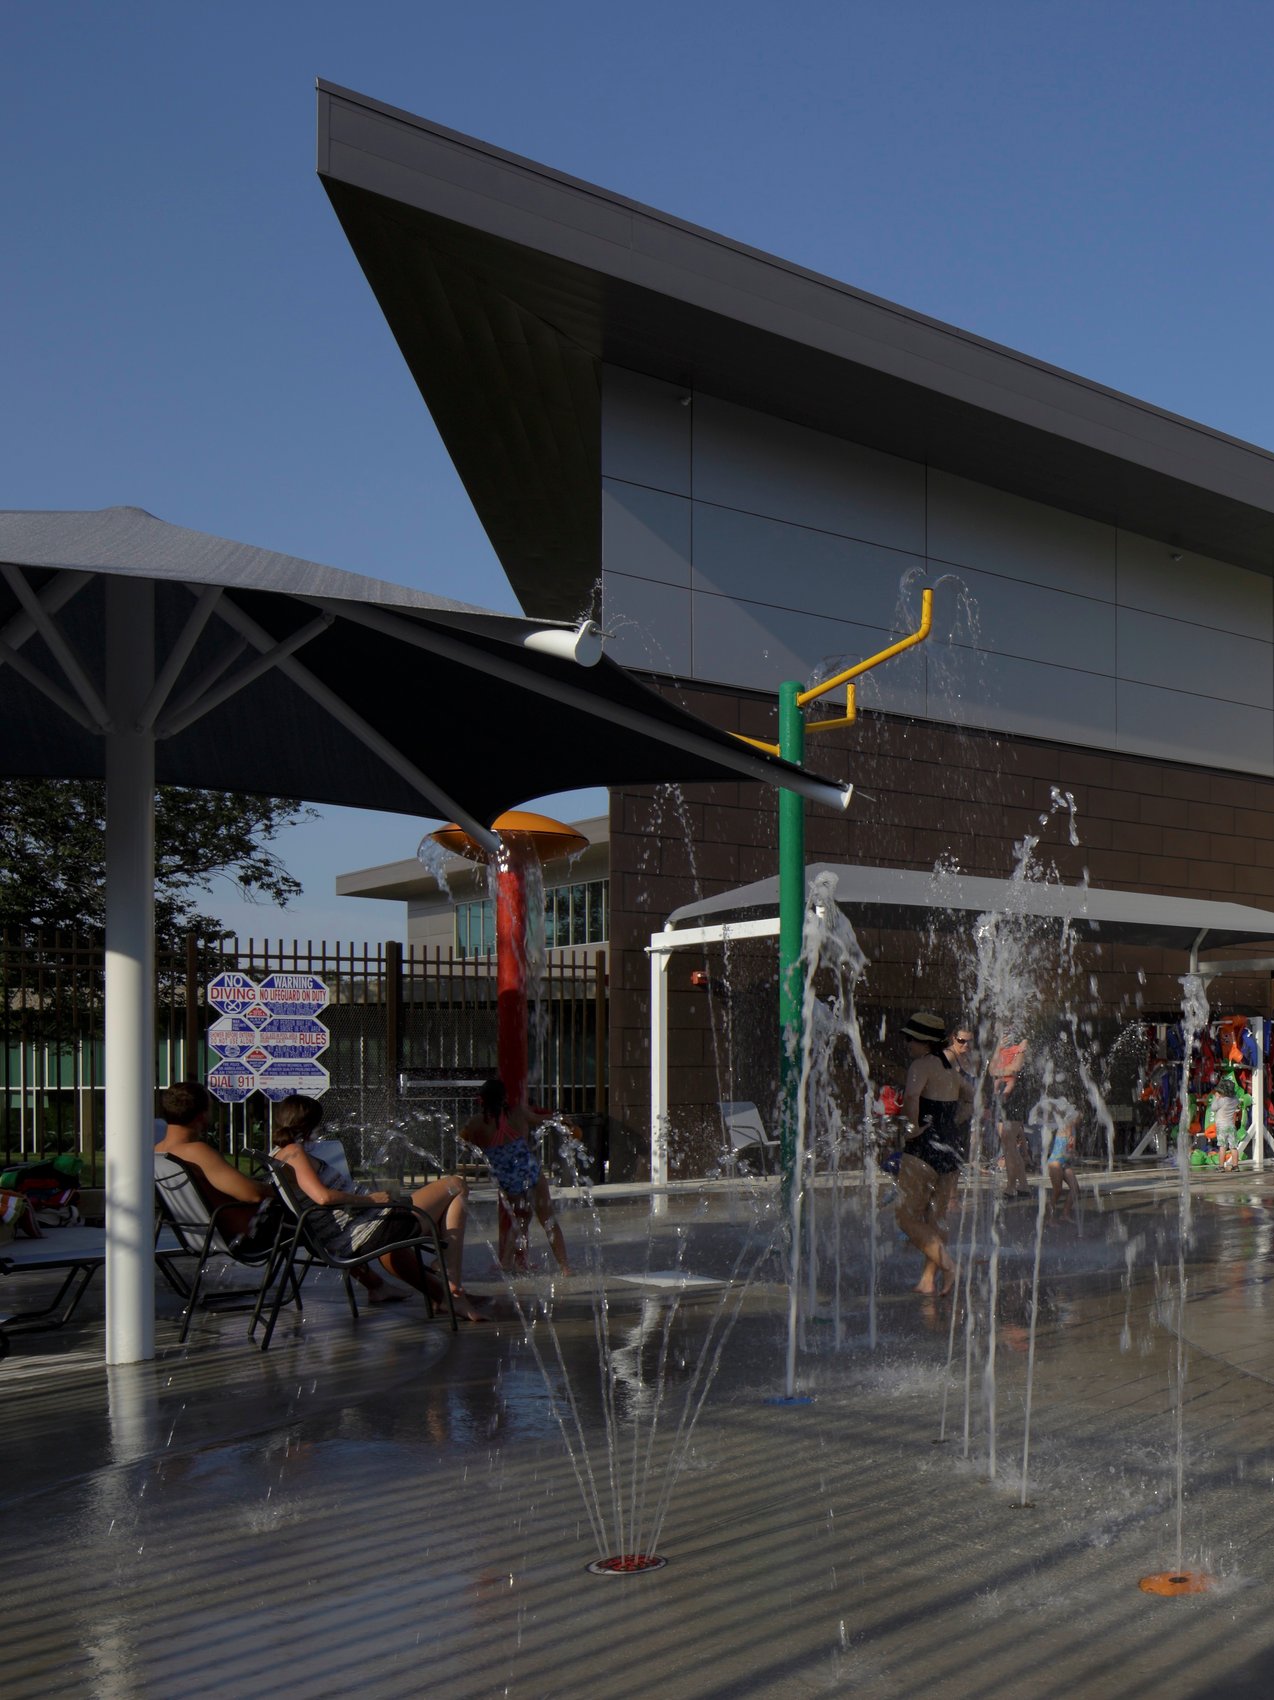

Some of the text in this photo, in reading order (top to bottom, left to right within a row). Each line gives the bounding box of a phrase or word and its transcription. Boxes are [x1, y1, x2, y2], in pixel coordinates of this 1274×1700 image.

[224, 976, 243, 987] NO
[274, 977, 313, 989] WARNING
[211, 988, 256, 1000] DIVING
[260, 990, 326, 1001] NO LIFEGUARD ON DUTY
[299, 1034, 326, 1045] RULES
[210, 1076, 233, 1087] DIAL
[238, 1076, 254, 1087] 911
